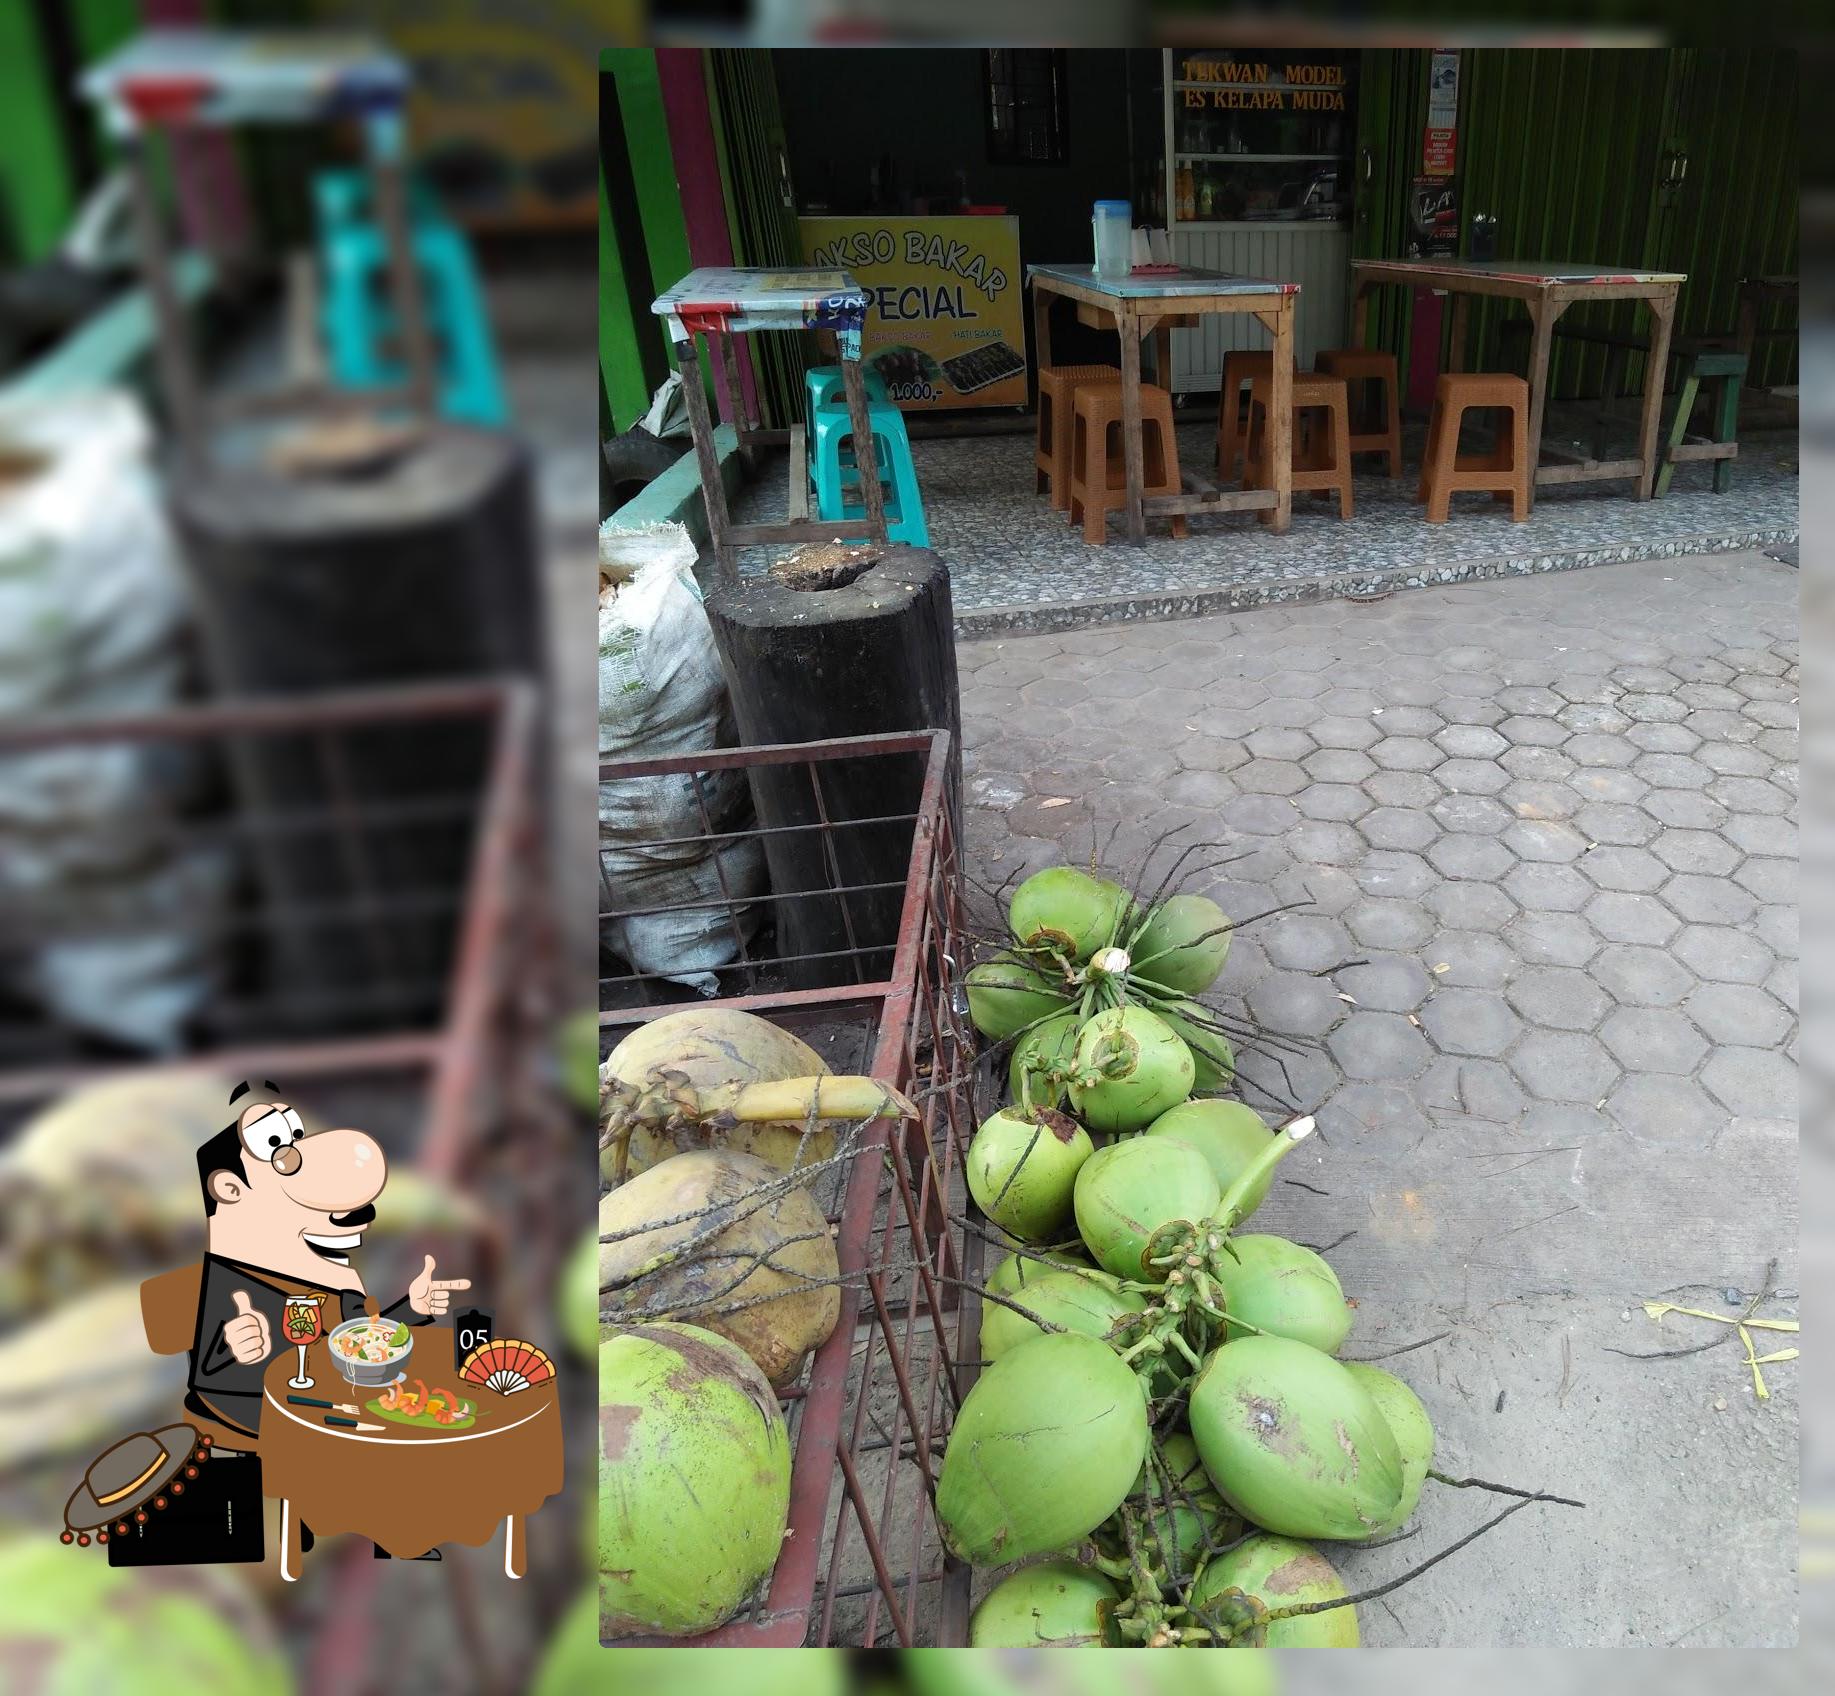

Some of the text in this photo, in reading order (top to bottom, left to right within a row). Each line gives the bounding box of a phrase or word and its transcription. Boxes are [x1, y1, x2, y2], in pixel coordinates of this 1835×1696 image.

[1183, 61, 1346, 85] TEKWAN MODEL
[1185, 88, 1345, 112] ES KELAPA MUDA
[814, 230, 1007, 302] AKSO BAKAR
[861, 287, 977, 320] PECIAL
